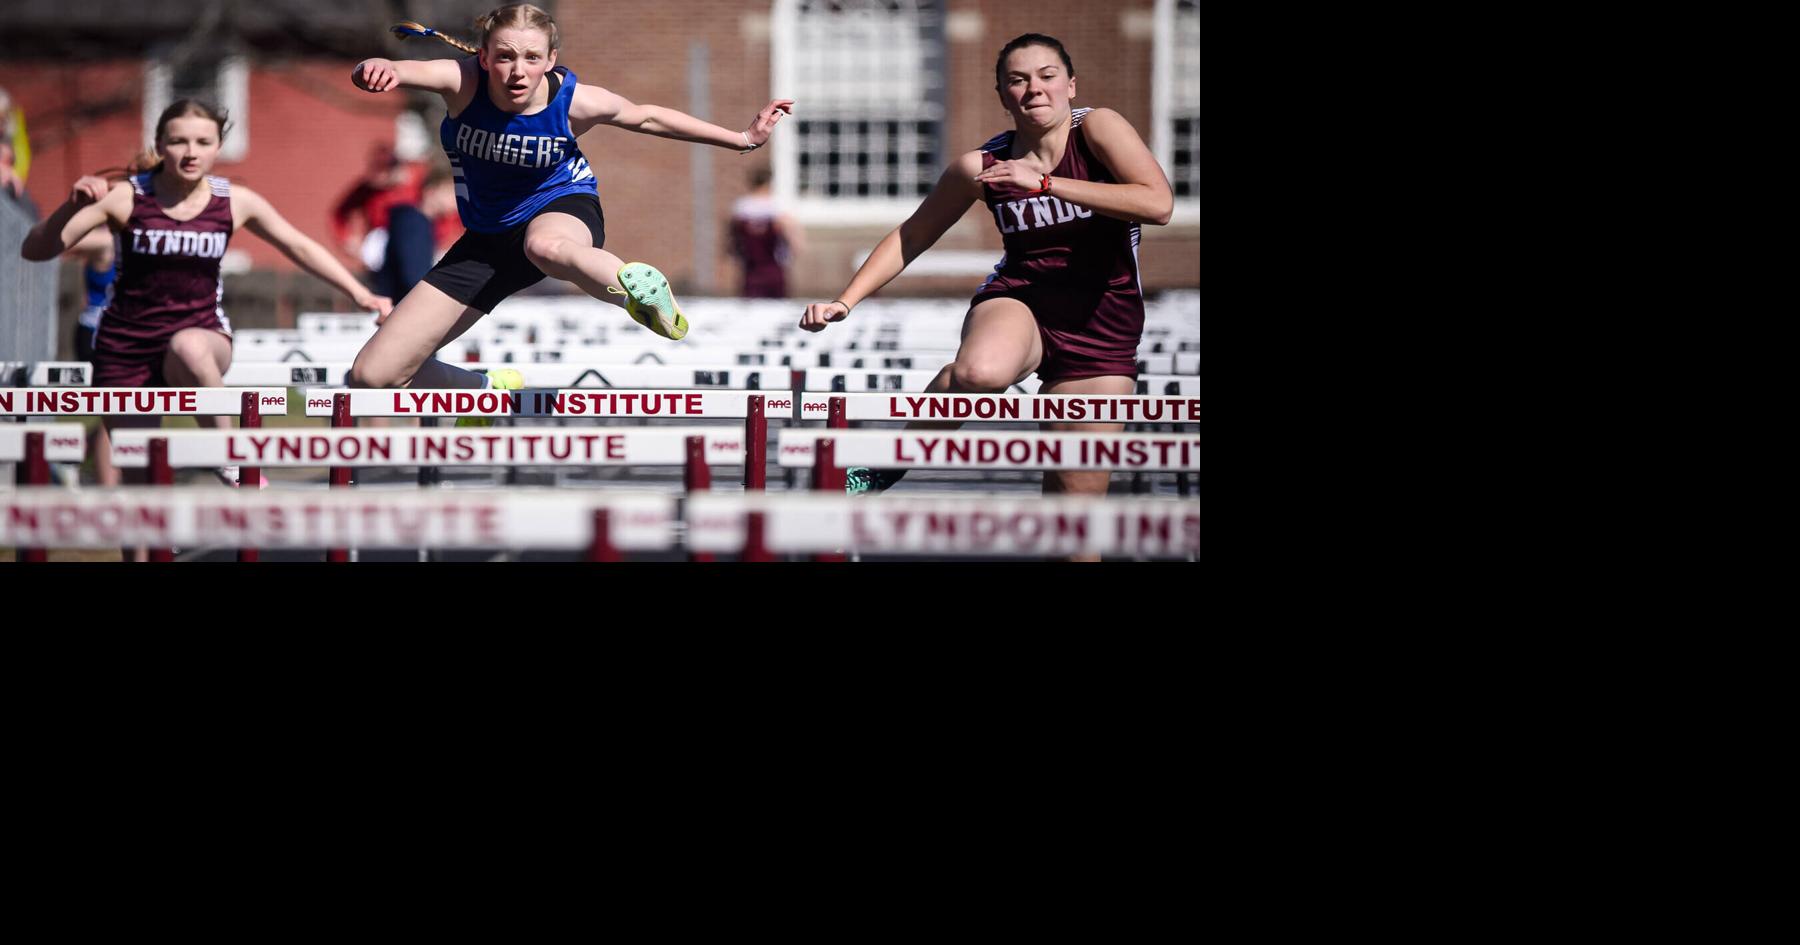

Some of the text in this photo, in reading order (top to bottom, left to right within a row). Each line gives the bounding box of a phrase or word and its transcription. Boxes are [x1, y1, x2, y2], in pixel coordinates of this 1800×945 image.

[456, 122, 568, 168] RANGERS
[132, 228, 227, 259] LYNDON
[26, 391, 197, 413] INSTITUTE
[393, 391, 703, 416] LYNDON INSTITUTE
[889, 396, 1200, 421] LYNDON INSTITUTE
[226, 435, 627, 462] LYNDON INSTITUTE
[894, 437, 1200, 467] LYNDON INSTI
[197, 505, 502, 545] INSTITUTE
[851, 510, 1088, 548] LYNDON
